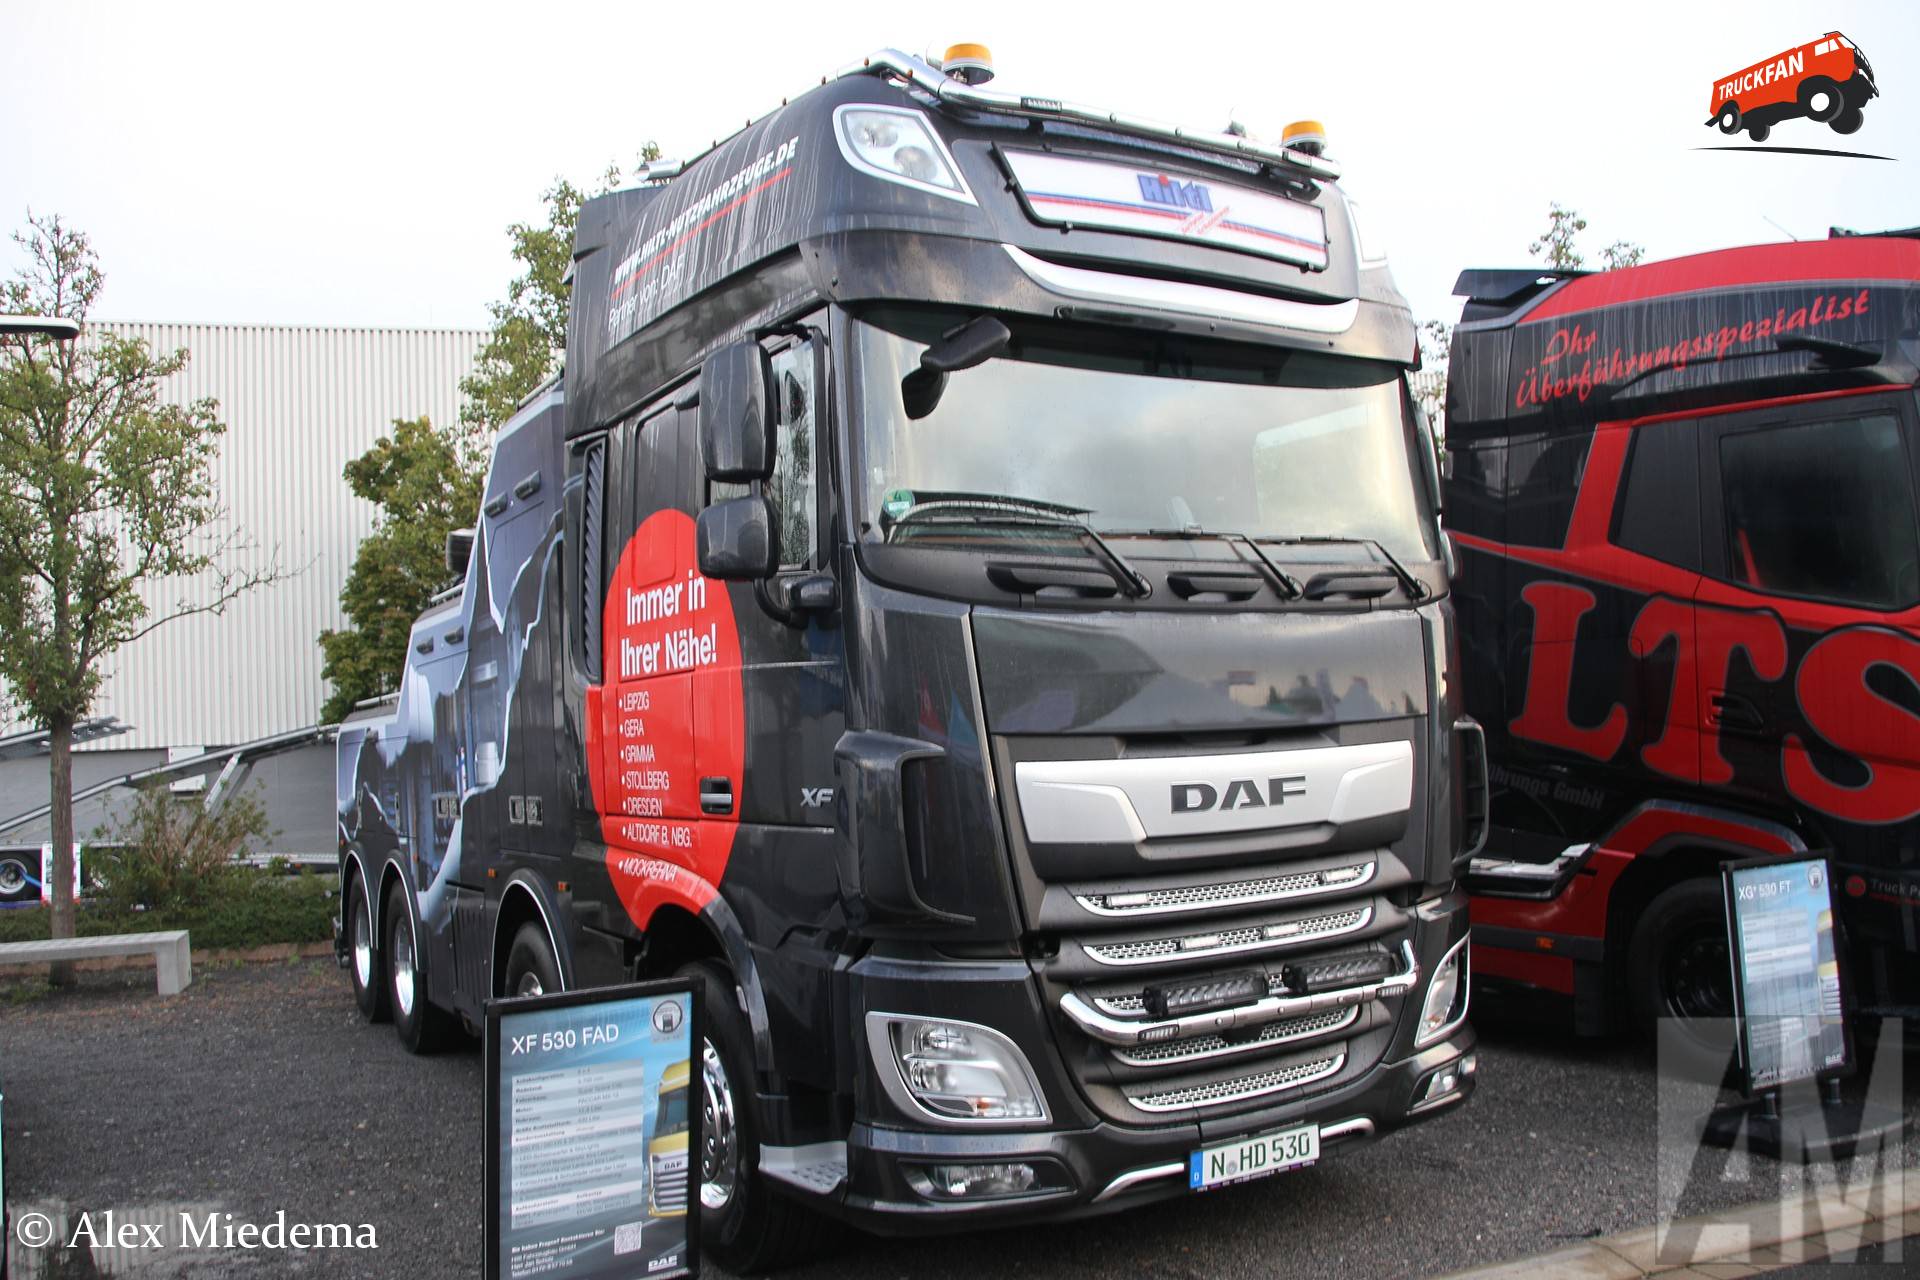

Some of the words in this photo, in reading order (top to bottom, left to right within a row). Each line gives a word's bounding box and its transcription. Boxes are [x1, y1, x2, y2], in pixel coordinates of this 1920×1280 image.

[661, 254, 686, 291] DAF
[1516, 289, 1871, 408] Überführungsspezialist
[1540, 324, 1597, 366] Ihr
[627, 582, 683, 626] Immer
[688, 569, 706, 612] in
[621, 637, 660, 677] Ihrer
[665, 623, 717, 670] Nähe!
[623, 691, 649, 712] LEIPZIG
[1508, 580, 1920, 825] LTS
[624, 718, 645, 738] GERA
[625, 744, 655, 763] GRIMMA
[626, 770, 670, 791] STOLLBERG
[627, 796, 663, 817] DRESDEN
[800, 787, 834, 808] XF
[1171, 775, 1306, 815] DAF
[627, 823, 660, 845] ALTDORF
[671, 829, 693, 848] NBG.
[1779, 880, 1792, 894] FT
[1870, 878, 1906, 896] Truck
[511, 1034, 538, 1055] XF
[542, 1029, 576, 1051] 530
[582, 1023, 619, 1046] FAD
[1211, 1151, 1225, 1179] N
[1240, 1143, 1266, 1172] HD
[1272, 1132, 1310, 1162] 530
